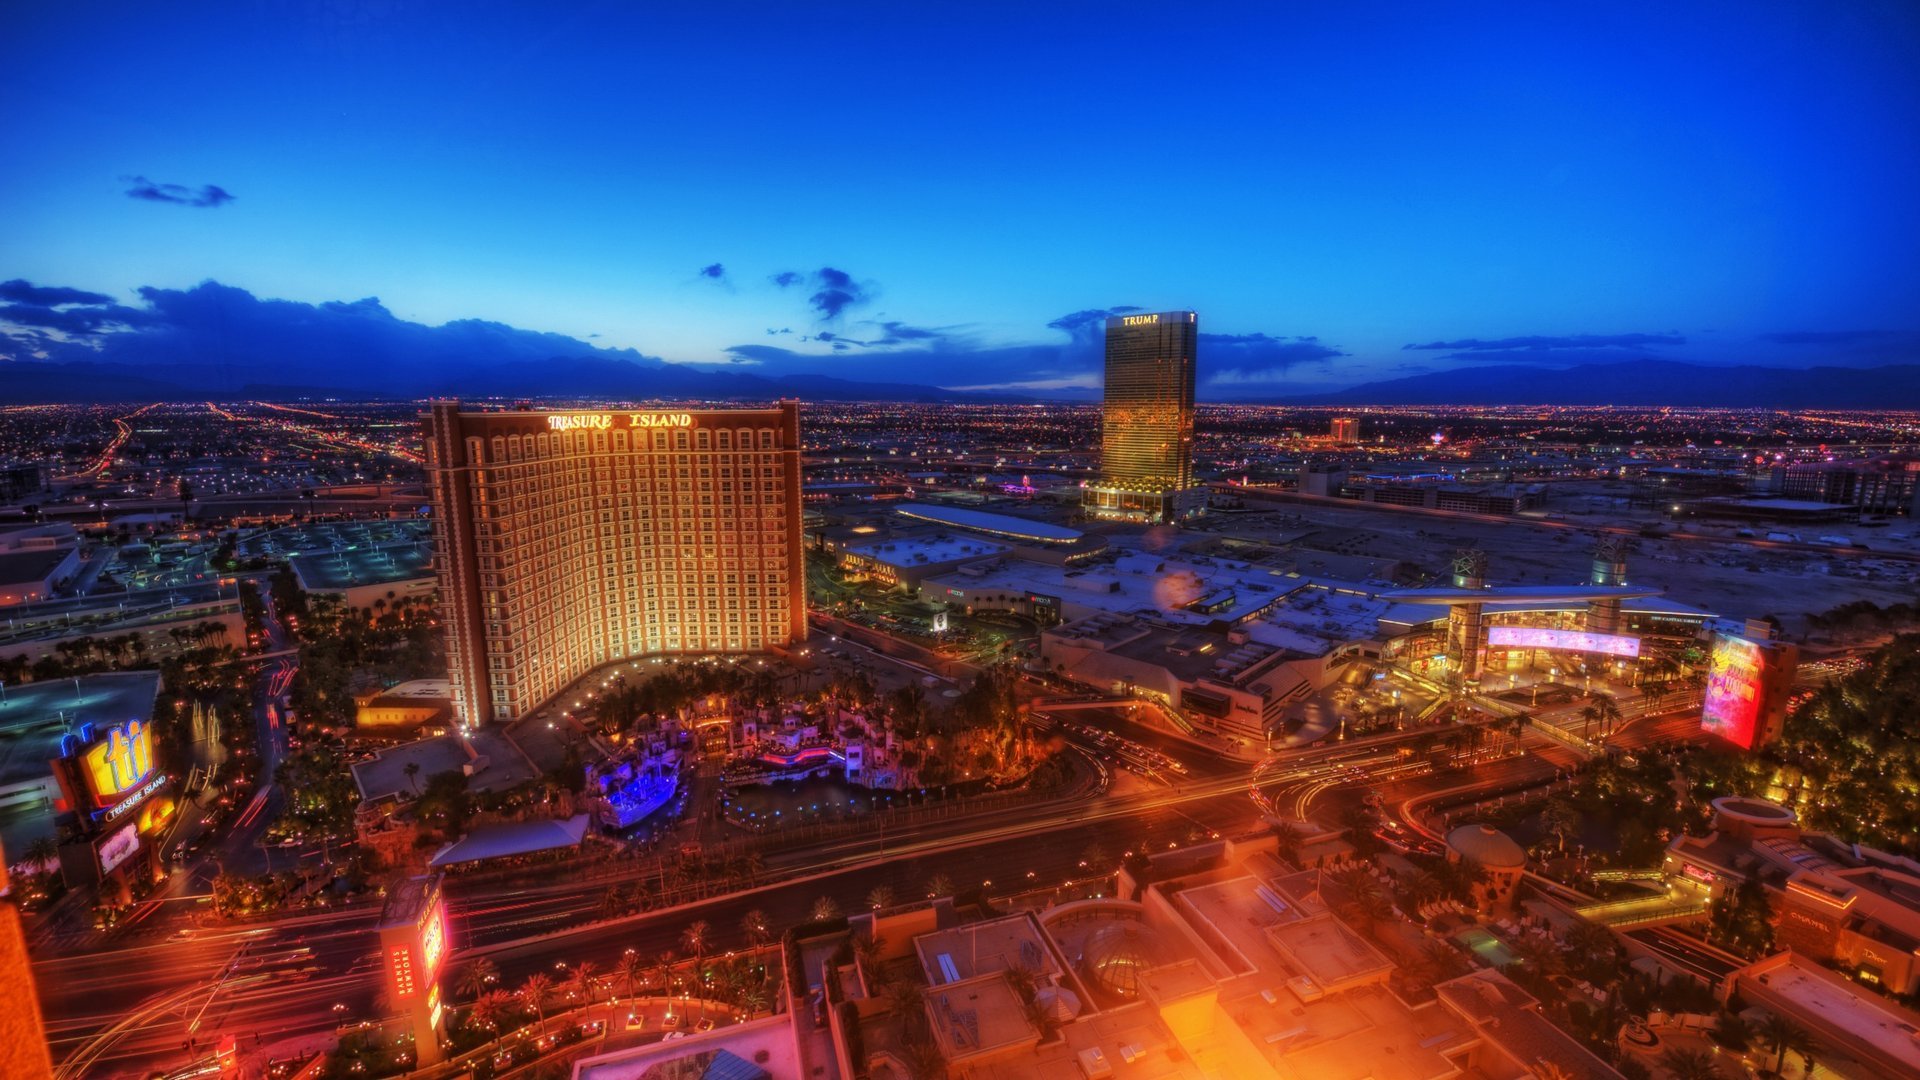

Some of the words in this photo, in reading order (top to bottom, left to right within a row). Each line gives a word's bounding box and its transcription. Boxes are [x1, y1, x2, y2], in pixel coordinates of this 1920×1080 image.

[1123, 314, 1158, 326] TRUMP
[548, 414, 612, 431] TREASURE
[630, 414, 691, 427] ISLAND
[107, 719, 147, 792] ti
[110, 791, 142, 819] TREASURE
[144, 775, 166, 796] ISLAND
[1791, 912, 1830, 933] CHANEL
[1863, 948, 1888, 964] Dior
[393, 951, 406, 995] BARNEYS
